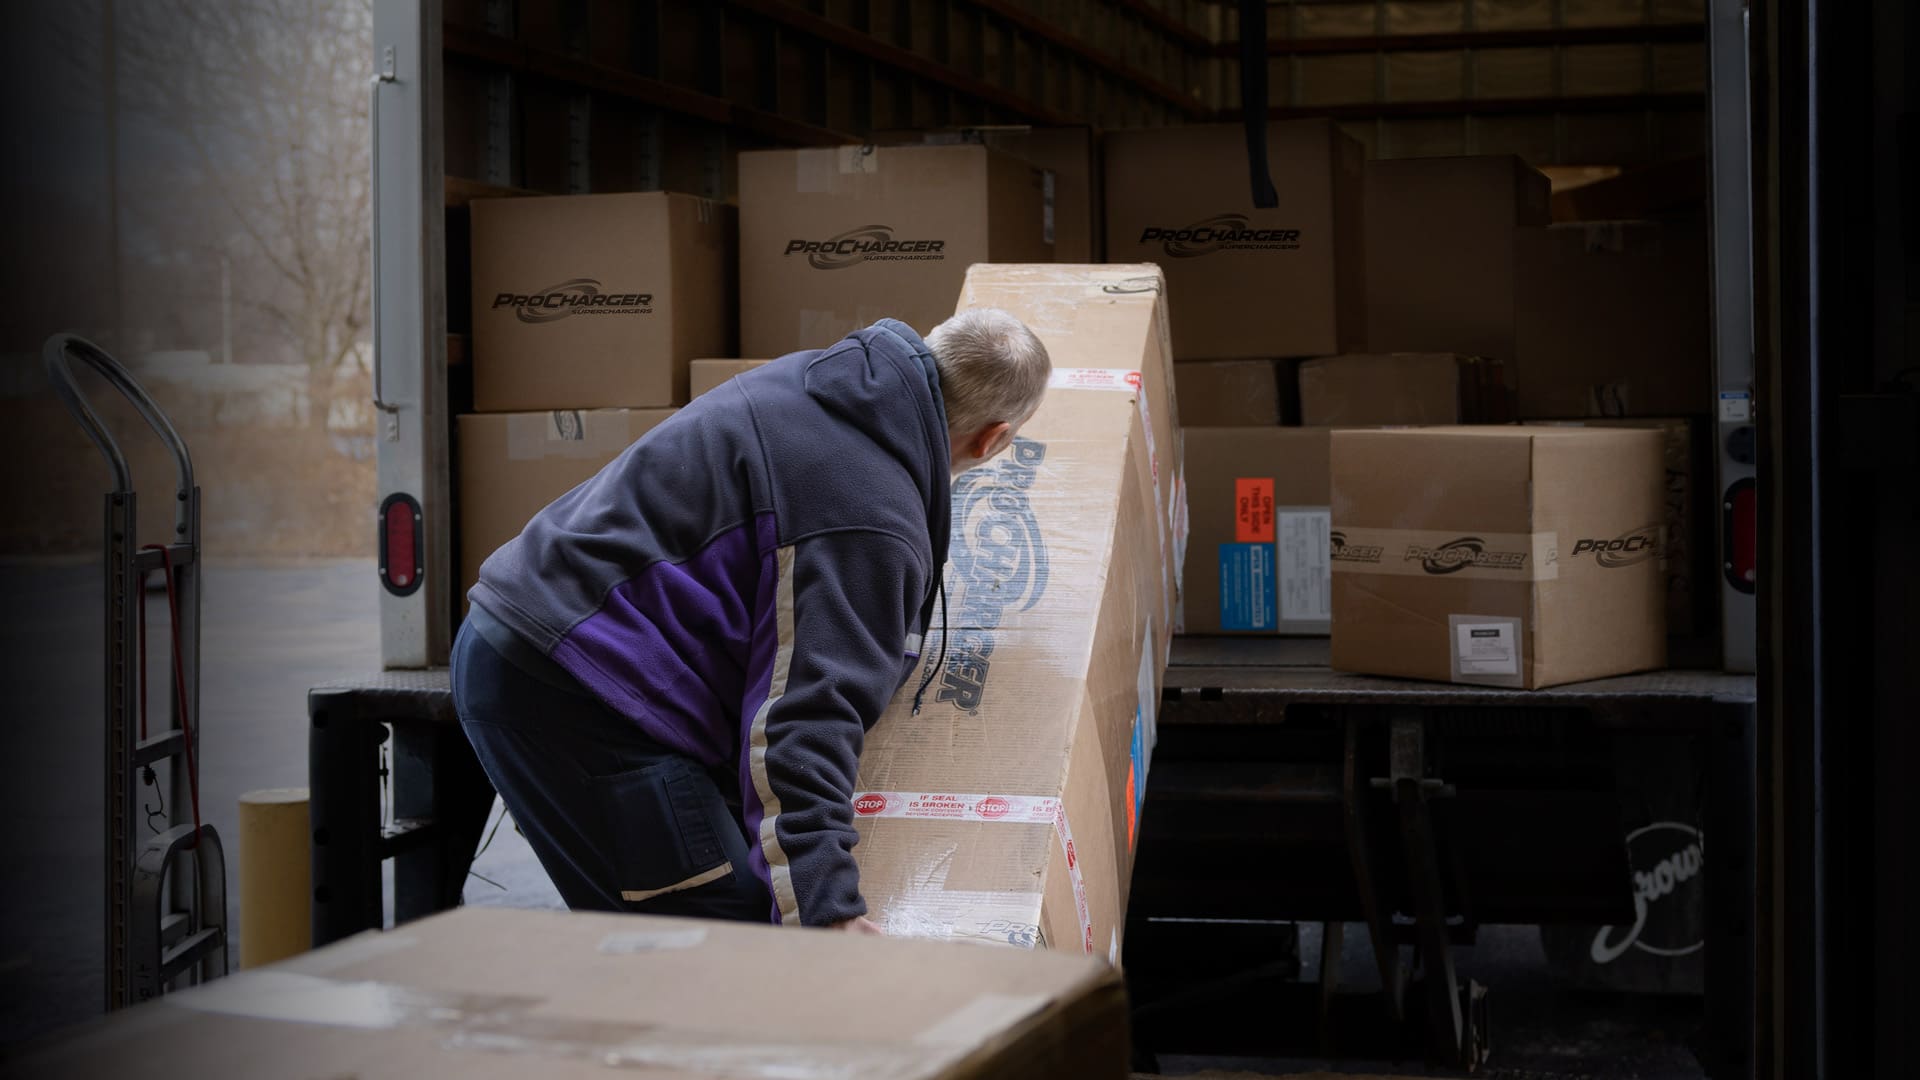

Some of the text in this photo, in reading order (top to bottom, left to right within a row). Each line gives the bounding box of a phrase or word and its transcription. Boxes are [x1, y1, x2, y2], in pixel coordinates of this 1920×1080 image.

[783, 239, 945, 256] PROCHARGER
[492, 292, 653, 309] PROCHARGER
[1240, 496, 1249, 523] ONLY
[1251, 487, 1261, 535] THIS SIDE
[1263, 495, 1272, 525] OPEN
[1331, 545, 1385, 560] ARGER
[1571, 536, 1654, 556] PROCH
[857, 800, 883, 809] STOP
[922, 801, 965, 809] BROKEN
[932, 794, 957, 802] SEAL
[979, 803, 1007, 812] STOP
